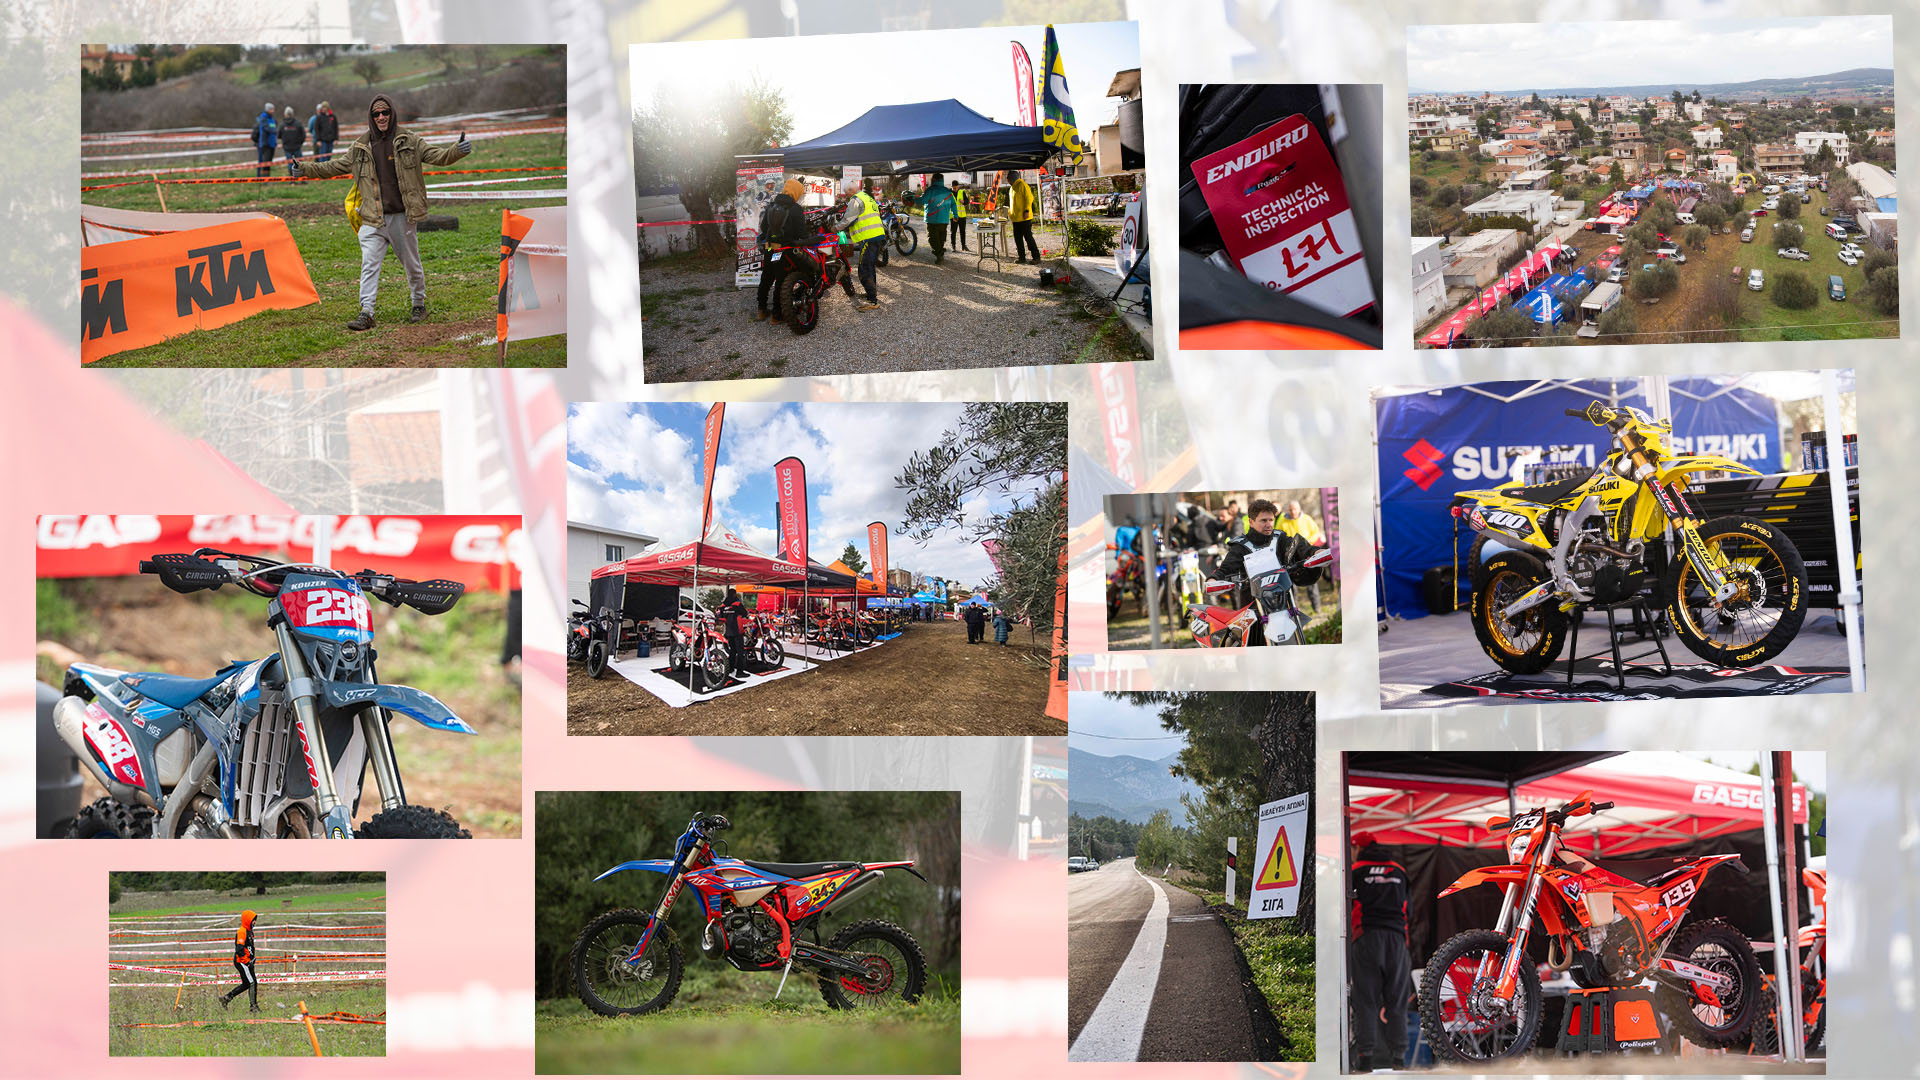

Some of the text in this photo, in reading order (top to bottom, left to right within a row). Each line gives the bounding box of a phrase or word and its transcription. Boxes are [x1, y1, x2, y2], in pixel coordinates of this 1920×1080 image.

[1206, 123, 1309, 185] ENDURO
[1241, 181, 1323, 225] TECHNICAL
[1245, 191, 1330, 239] INSPECTION
[1123, 228, 1134, 246] 30
[175, 240, 276, 318] KTM
[1588, 480, 1620, 494] SUZUKI
[1486, 511, 1527, 529] 100
[658, 548, 695, 564] GASGAS
[1688, 528, 1715, 568] DUNLOP
[185, 571, 216, 580] CIRCUIT
[772, 563, 806, 576] GASGAS
[291, 581, 326, 591] KOUZEN
[412, 593, 444, 603] CIRCUIT
[306, 590, 369, 628] 238
[1662, 878, 1697, 909] 133
[1261, 898, 1284, 912] ΣΙΓΑ
[1623, 1040, 1657, 1049] Polisport
